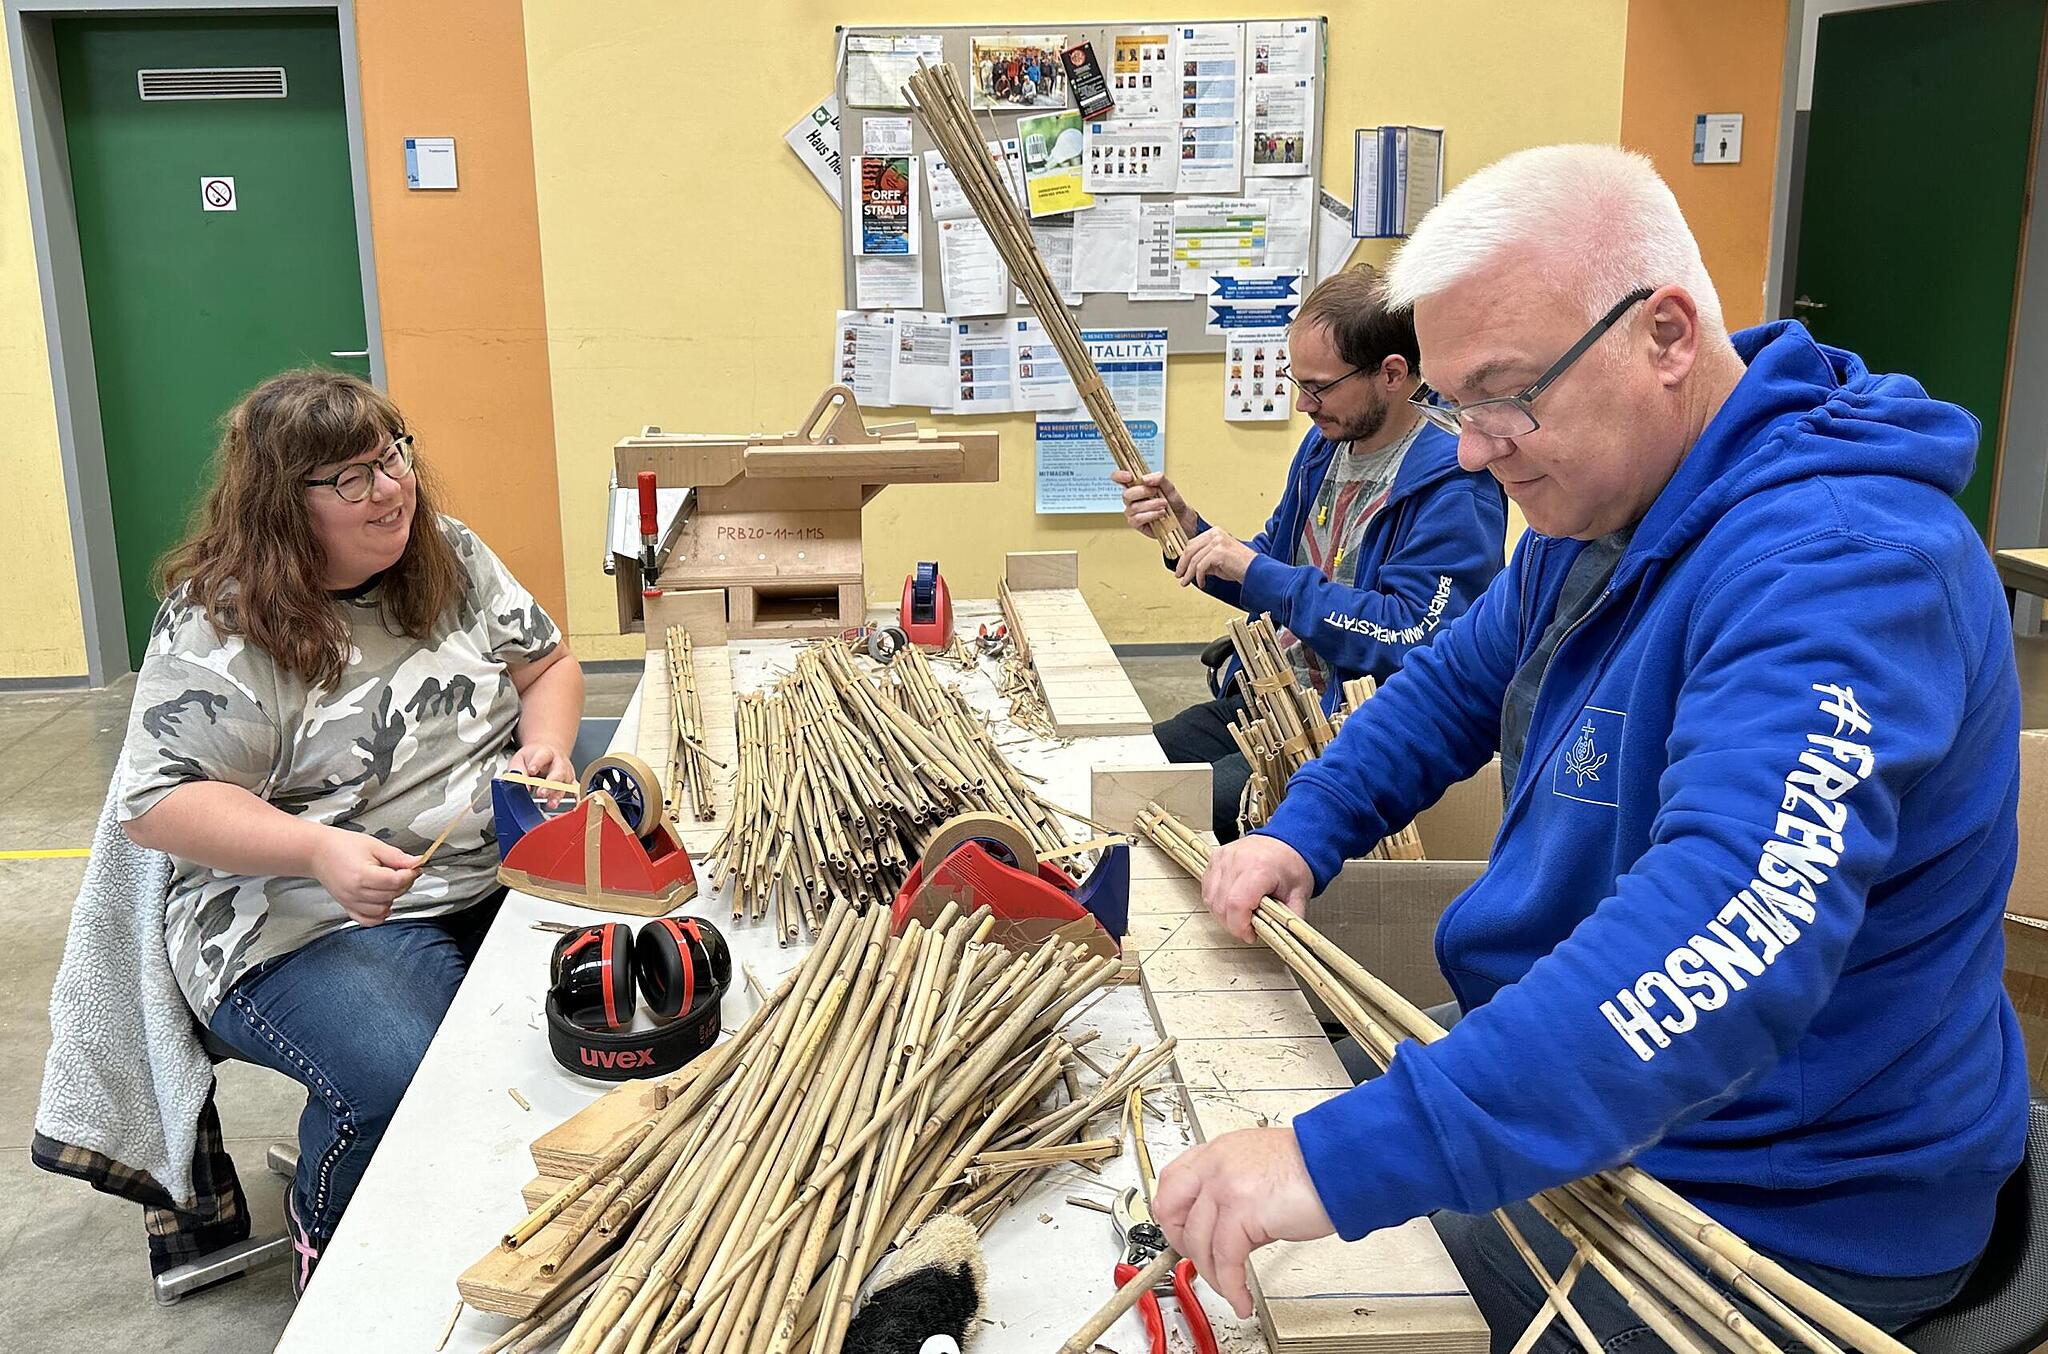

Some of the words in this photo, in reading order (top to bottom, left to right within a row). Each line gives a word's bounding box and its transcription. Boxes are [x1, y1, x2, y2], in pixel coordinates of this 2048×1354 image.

[806, 128, 830, 156] Haus
[871, 190, 901, 200] ORFF
[864, 205, 907, 215] STRAUB
[1089, 342, 1164, 357] ITALITÄT
[580, 1047, 656, 1069] uvex
